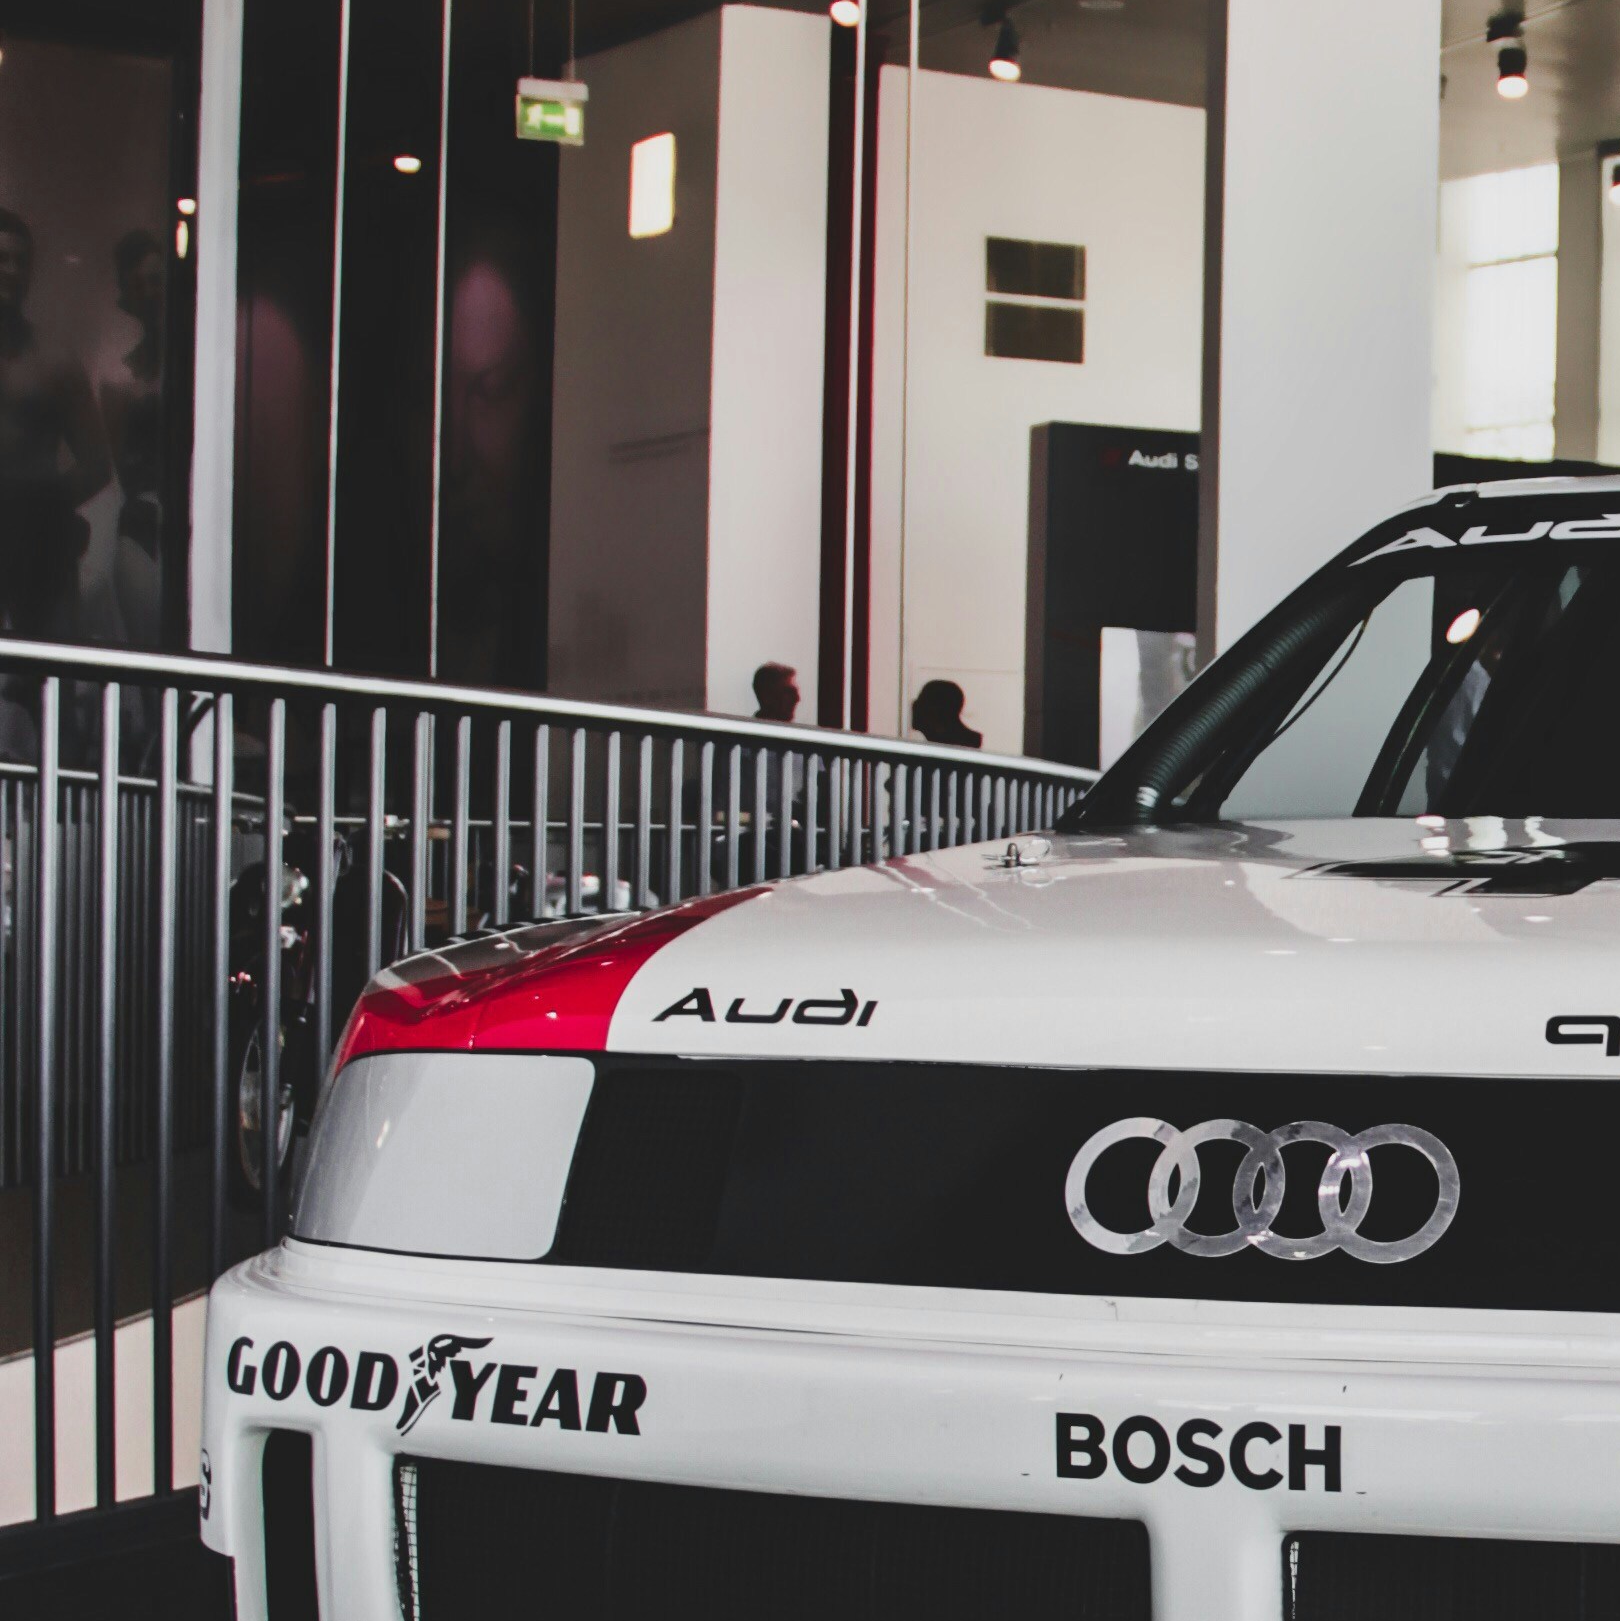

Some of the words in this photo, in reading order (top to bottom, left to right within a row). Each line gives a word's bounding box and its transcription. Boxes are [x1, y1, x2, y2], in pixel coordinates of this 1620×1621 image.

[1128, 449, 1179, 469] Audi
[651, 986, 879, 1028] Audi
[1054, 1411, 1343, 1494] BOSCH
